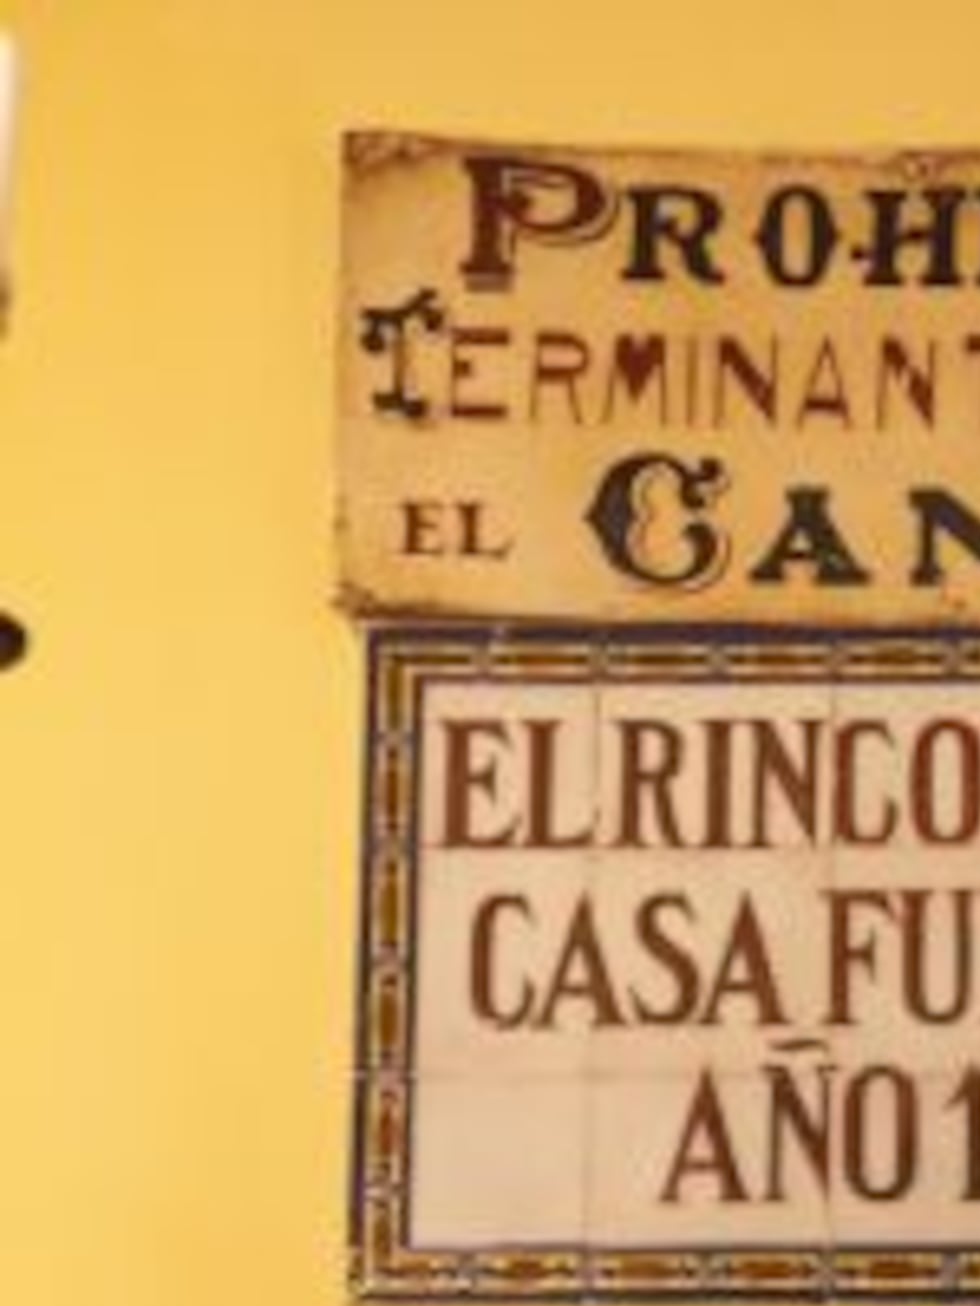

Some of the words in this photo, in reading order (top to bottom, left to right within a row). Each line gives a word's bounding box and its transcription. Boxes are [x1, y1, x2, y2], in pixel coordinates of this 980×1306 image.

[400, 500, 514, 560] EL
[440, 718, 595, 850] EL
[468, 888, 788, 1032] CASA
[658, 1038, 920, 1204] AÑO
